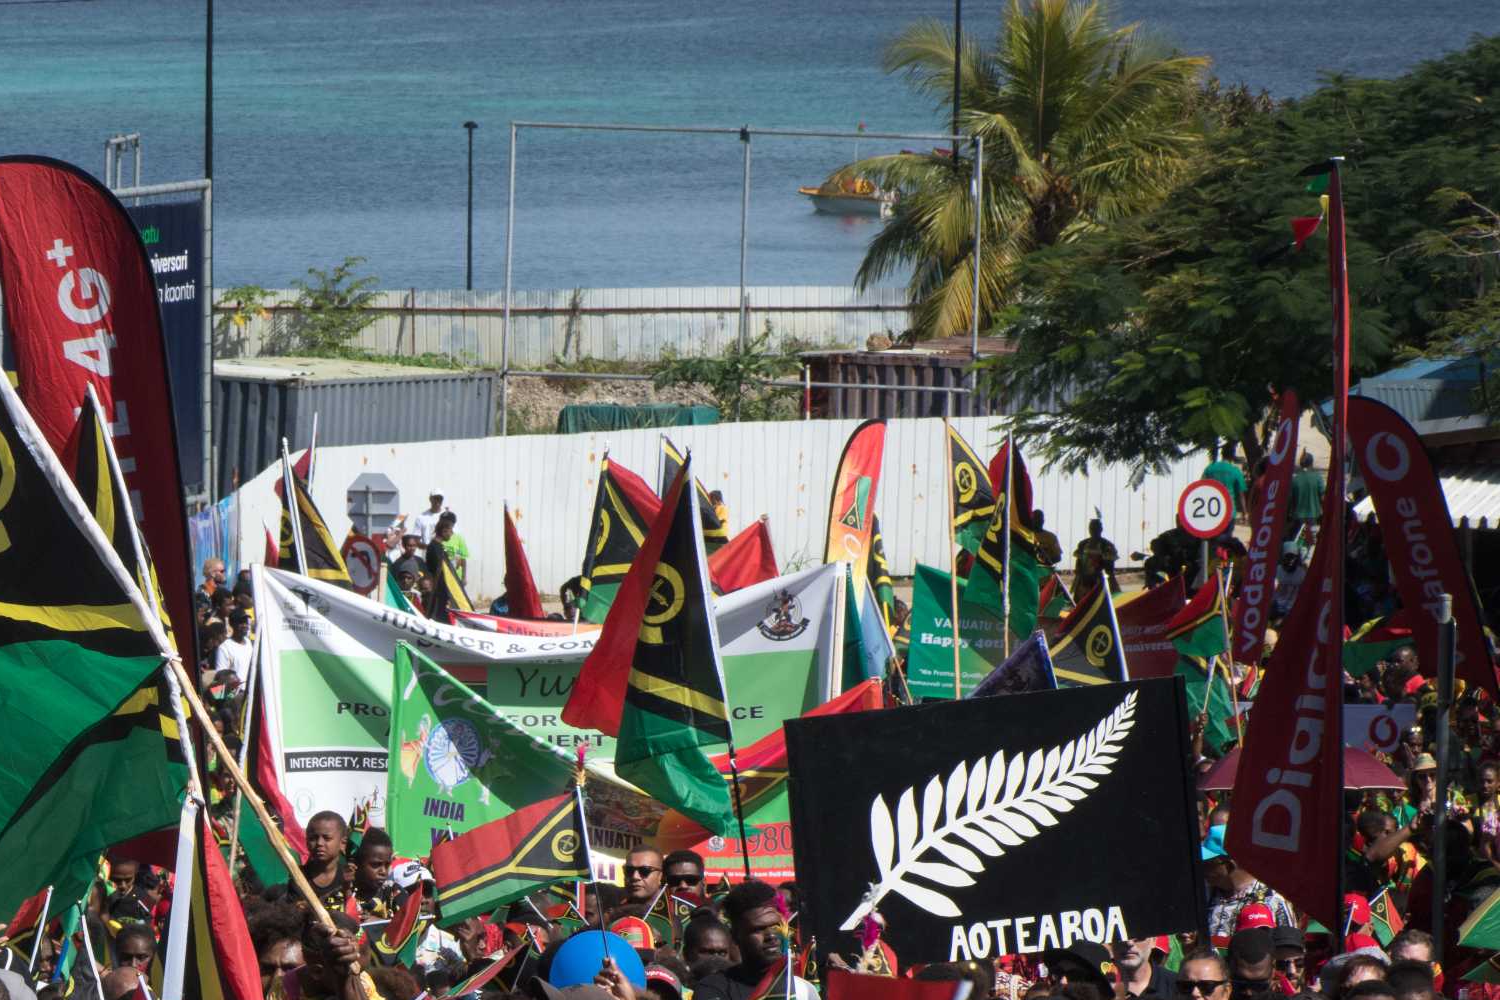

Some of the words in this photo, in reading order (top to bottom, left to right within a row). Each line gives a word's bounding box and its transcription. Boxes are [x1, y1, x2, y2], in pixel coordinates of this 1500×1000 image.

[1191, 496, 1222, 519] 20
[1241, 479, 1280, 653] vodafone
[934, 617, 993, 631] VAUATU
[506, 643, 526, 653] &
[515, 667, 576, 698] Yu
[336, 702, 391, 717] PRO
[732, 705, 764, 720] CE
[289, 756, 360, 769] INTERGRETY,
[423, 796, 466, 822] INDIA
[948, 905, 1130, 963] AOTEAROA
